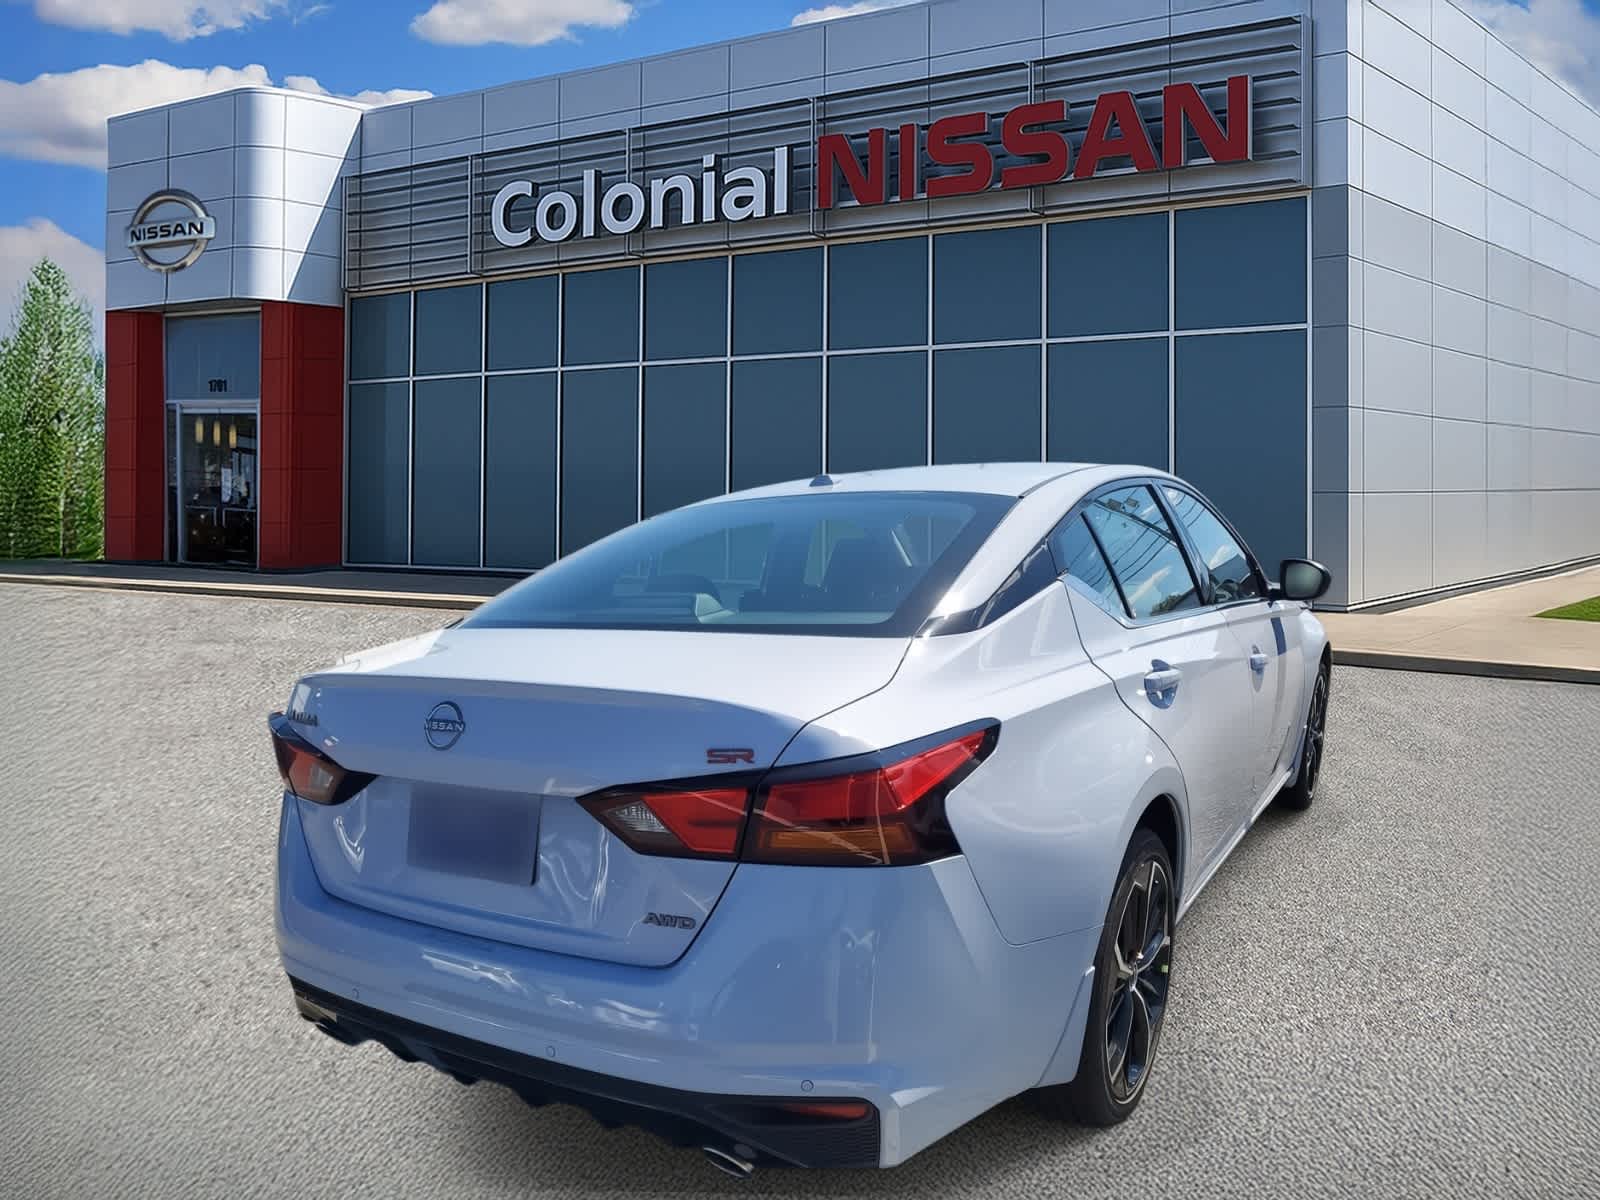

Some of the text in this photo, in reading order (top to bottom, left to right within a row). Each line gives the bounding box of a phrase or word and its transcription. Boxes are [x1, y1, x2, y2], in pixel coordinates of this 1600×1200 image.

[491, 75, 1254, 248] Colonial NISSAN
[130, 221, 204, 242] NISSAN
[706, 748, 755, 764] SR
[641, 912, 697, 930] AWD
